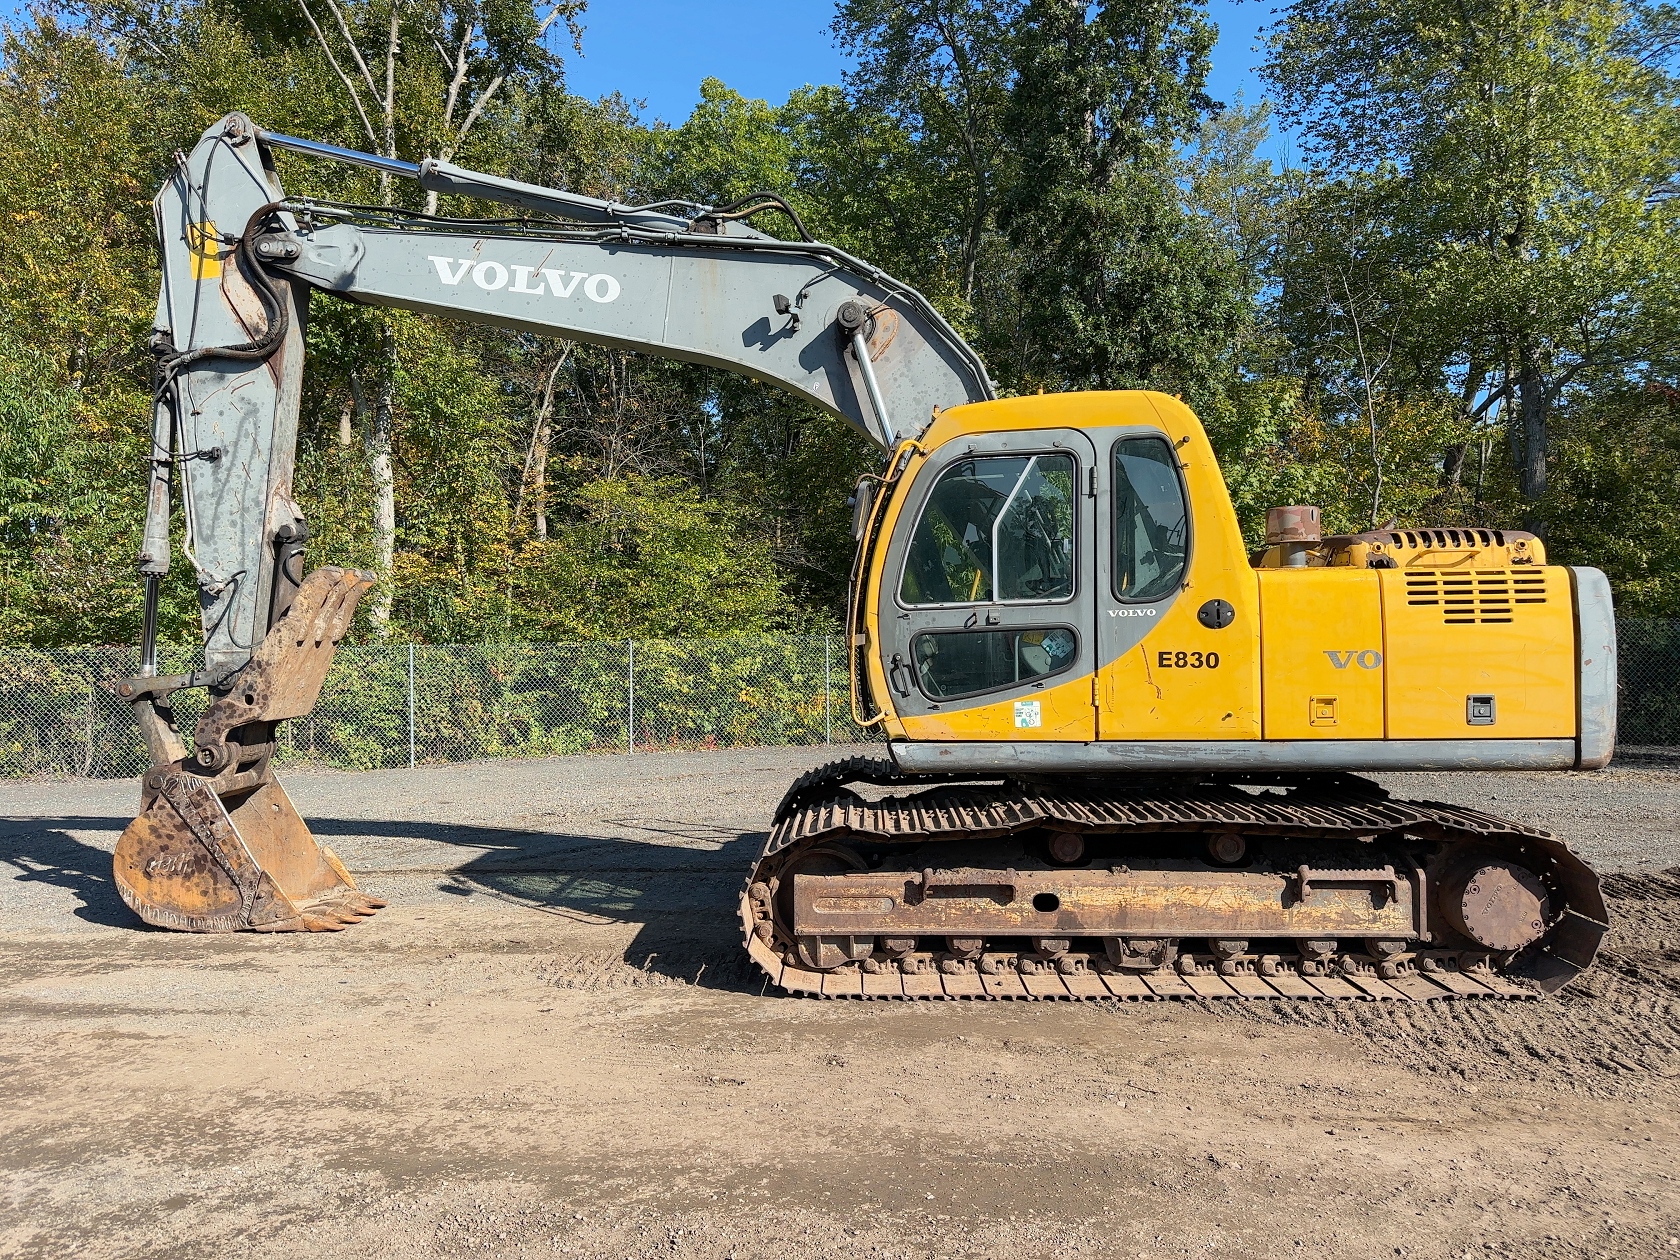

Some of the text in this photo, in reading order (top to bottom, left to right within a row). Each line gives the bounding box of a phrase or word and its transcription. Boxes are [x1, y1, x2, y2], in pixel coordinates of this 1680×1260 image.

[427, 255, 621, 303] VOLVO
[1107, 608, 1157, 617] VOLVO
[1158, 651, 1220, 669] E830
[1323, 649, 1383, 669] VO
